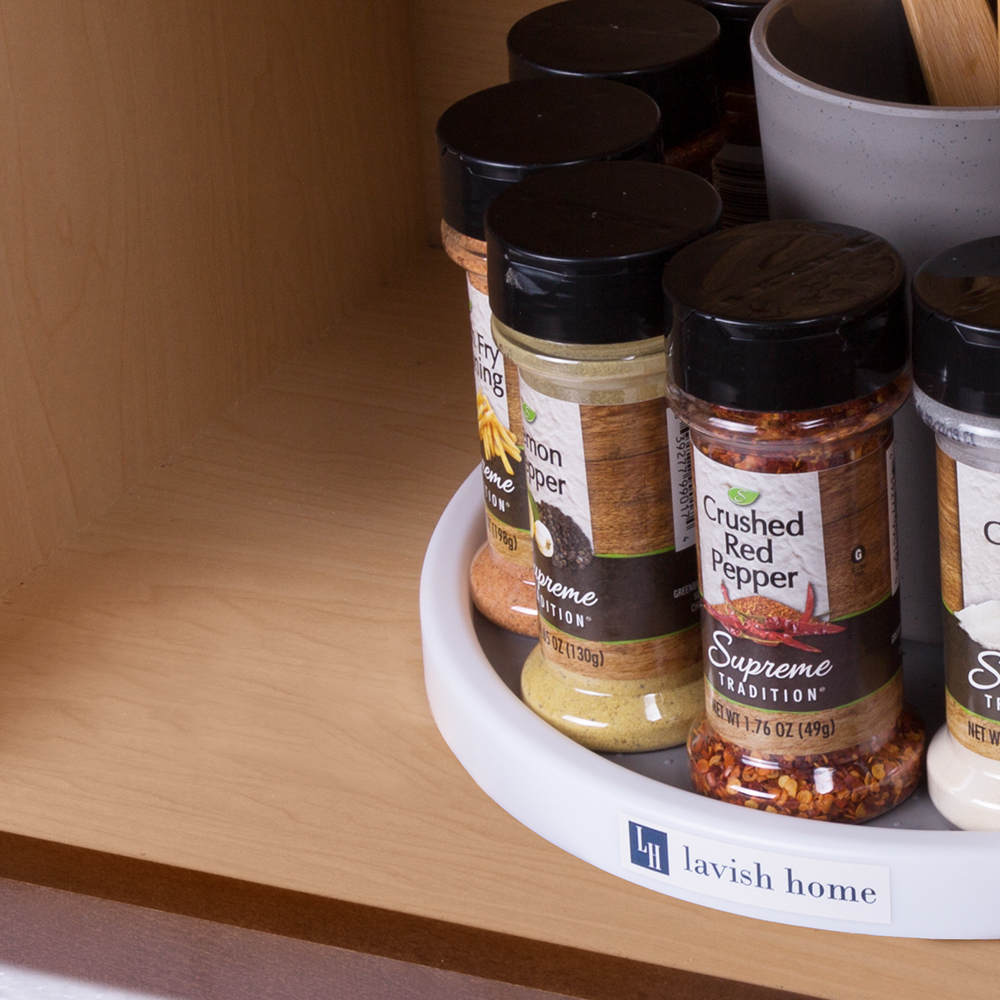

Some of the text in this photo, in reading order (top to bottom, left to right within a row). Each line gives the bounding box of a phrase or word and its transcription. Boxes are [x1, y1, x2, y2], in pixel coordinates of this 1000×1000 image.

[477, 333, 500, 369] Fry
[524, 433, 562, 467] mon
[526, 461, 566, 495] pper
[703, 494, 805, 537] Crushed
[724, 532, 774, 565] Red
[534, 564, 599, 607] upreme
[712, 548, 799, 593] Pepper
[537, 589, 585, 628] DITION
[552, 635, 564, 655] OZ
[566, 642, 604, 668] (130g)
[707, 630, 833, 682] Supreme
[718, 671, 818, 703] TRADITION
[712, 701, 836, 739] NET WT 1.76 OZ (49g)
[967, 721, 986, 742] NET
[683, 845, 774, 891] lavish
[785, 867, 877, 905] home
